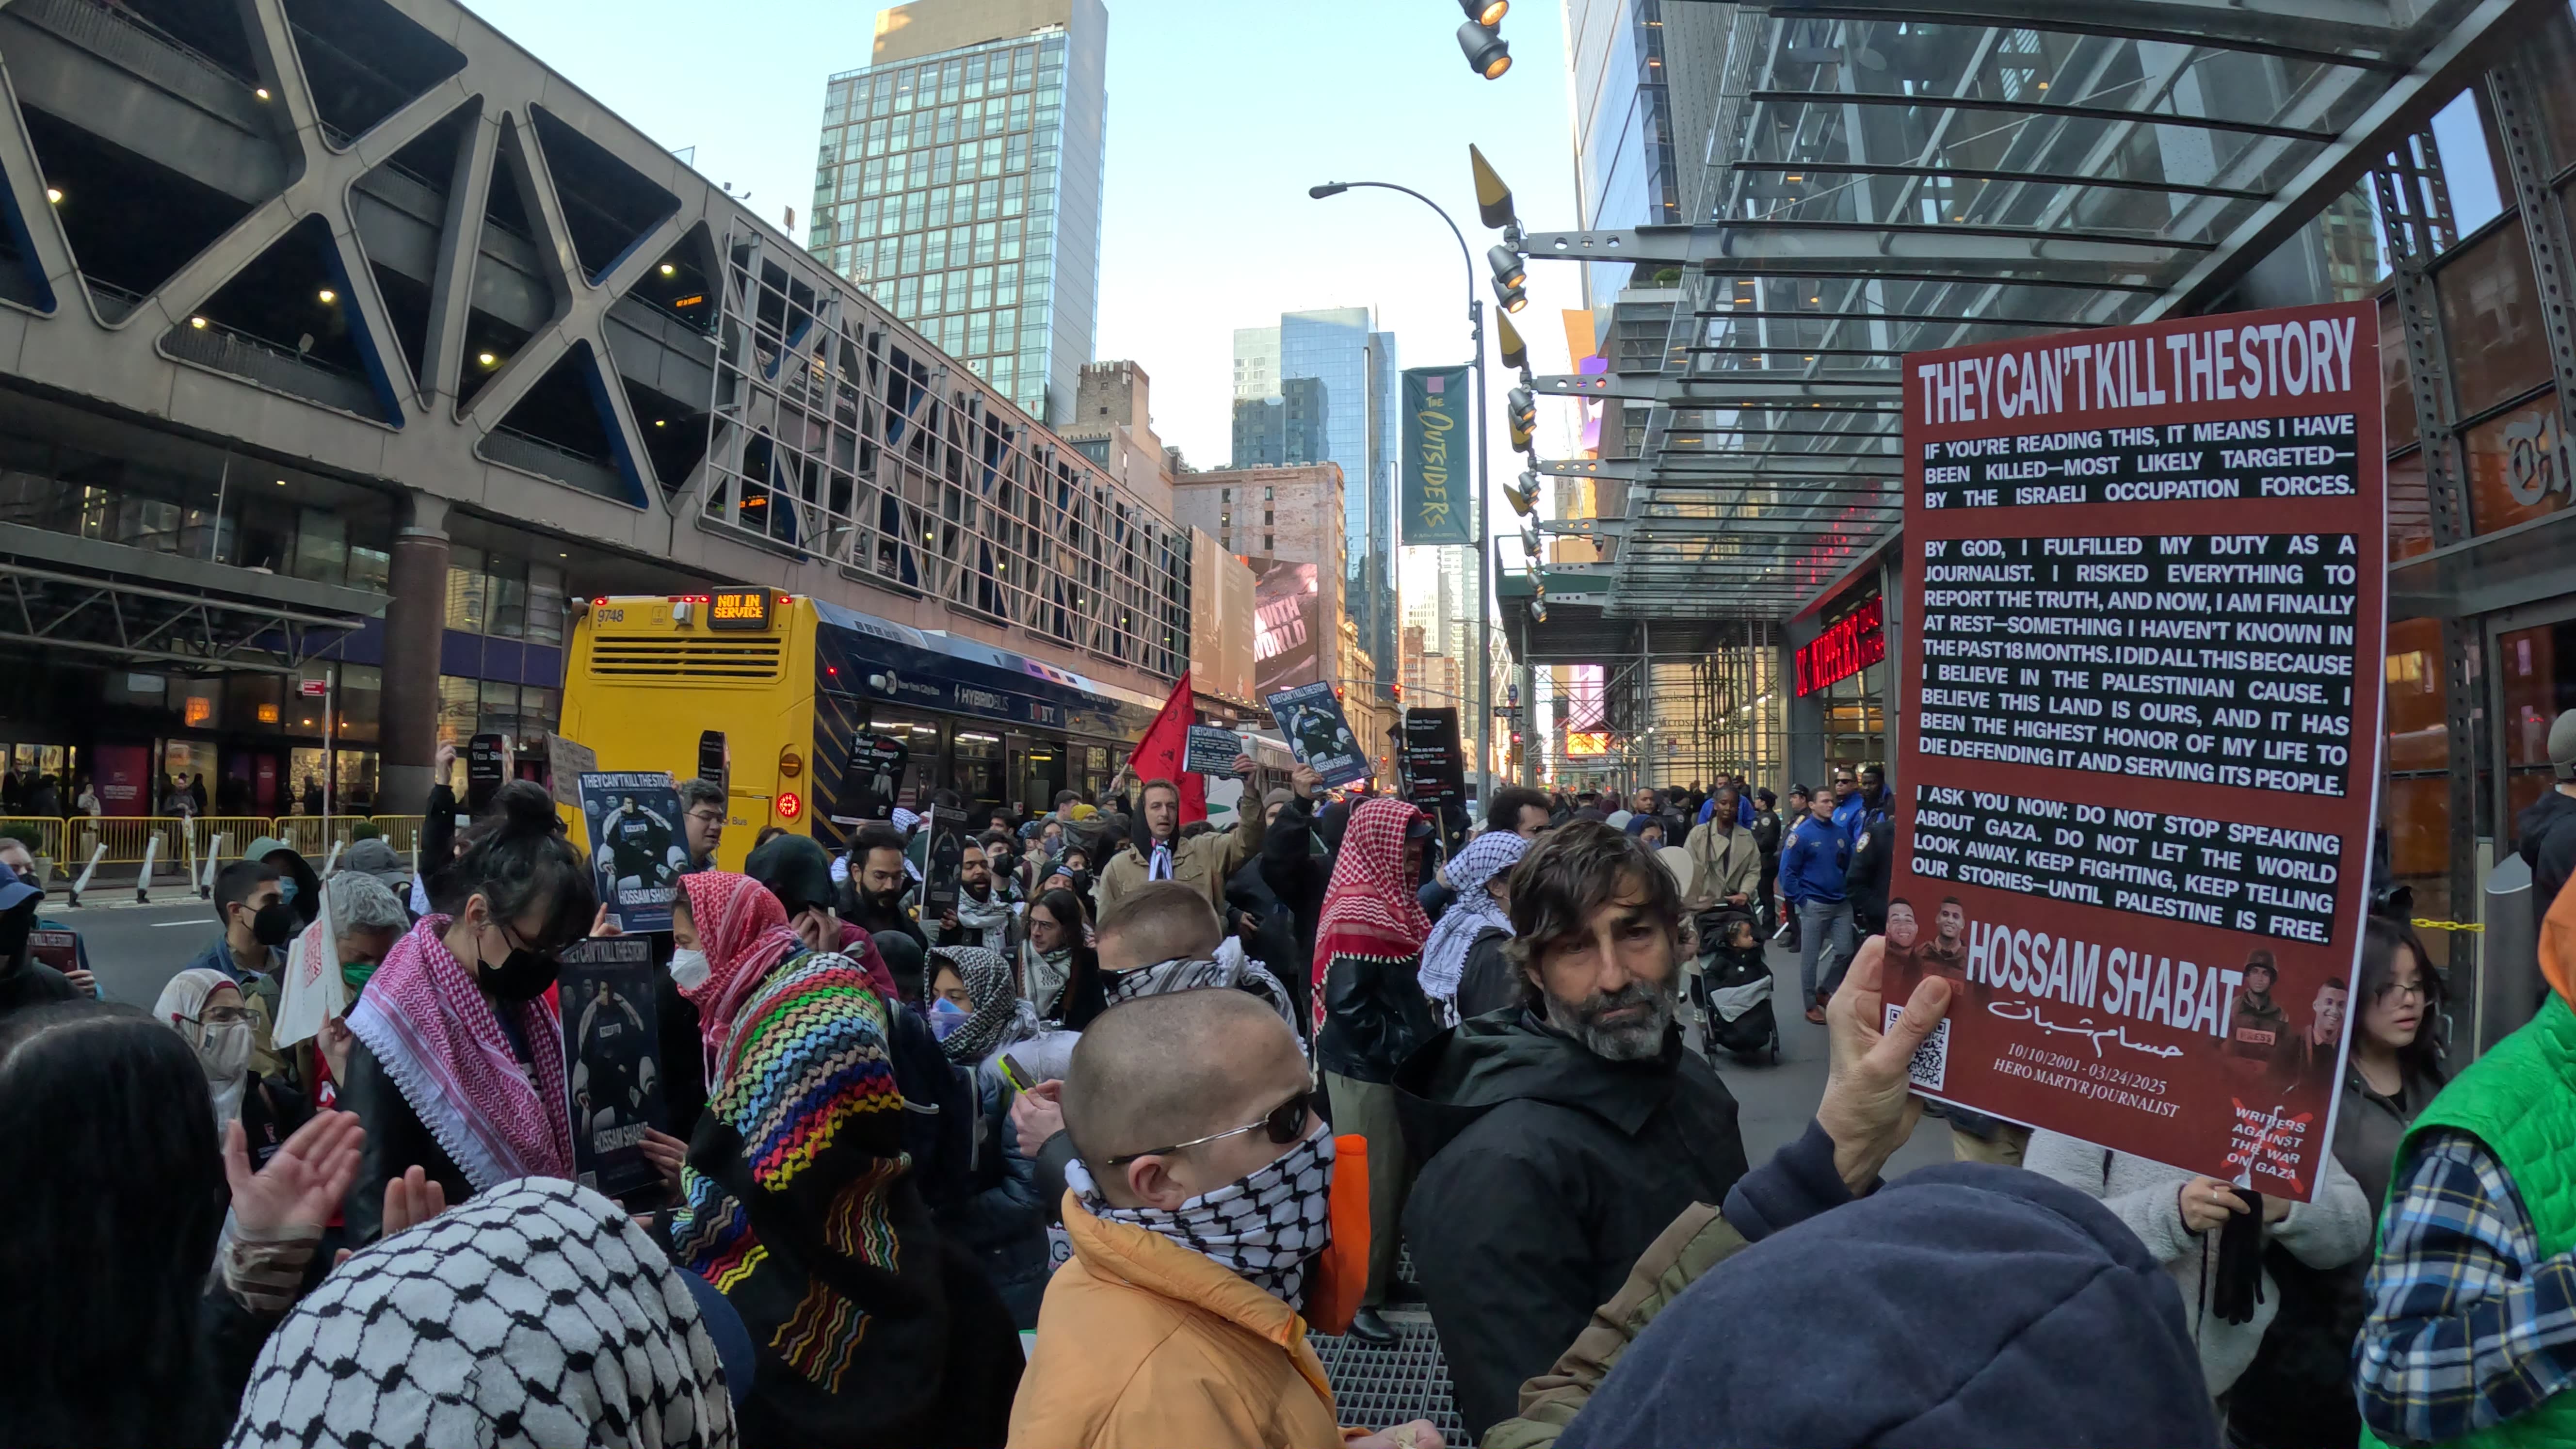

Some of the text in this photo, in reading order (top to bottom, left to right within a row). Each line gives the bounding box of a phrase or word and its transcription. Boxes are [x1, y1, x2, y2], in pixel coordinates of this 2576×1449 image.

[1918, 317, 2356, 425] THEY CAN'T KILL THE STORY
[1925, 415, 2354, 460] IF YOU'RE READING THIS, IT MEANS I HAVE
[1925, 466, 1970, 484] BEEN
[2137, 451, 2203, 473] LIKELY
[1925, 474, 2355, 509] BY THE ISRAELI OCCUPATION FORCES.
[1925, 535, 2356, 559] BY GOD, I FULFILLED MY DUTY AS A
[1924, 564, 2355, 585] JOURNALIST. I RISKED EVERYTHING TO
[597, 609, 624, 623] 9748
[714, 606, 763, 619] SERVICE
[718, 595, 760, 607] NOT IN
[1924, 590, 2355, 615] REPORT THE TRUTH, AND NOW, I AM FINALLY
[1923, 614, 1946, 631] AT
[2128, 619, 2134, 637] I
[2141, 619, 2231, 640] HAVEN'T
[2237, 622, 2322, 644] KNOWN
[2330, 625, 2353, 645] IN
[1922, 639, 2352, 676] THE PAST 18 MONTHS. I DID ALL THIS BECAUSE
[1922, 663, 2089, 689] I BELIEVE IN THE
[582, 774, 601, 788] THEY
[600, 773, 624, 788] CAN'T
[623, 773, 641, 788] KILL
[638, 773, 653, 788] THE
[1919, 737, 2344, 796] DIE DEFENDING IT AND SERVING ITS PEOPLE.
[1916, 785, 2339, 855] I ASK YOU NOW: DO NOT STOP SPEAKING
[1915, 809, 2337, 884] ABOUT GAZA. DO NOT LET THE WORLD
[1914, 833, 2333, 914] LOOK AWAY. KEEP FIGHTING, KEEP TELLING
[619, 888, 651, 905] HOSSAM
[1912, 857, 1948, 878] OUR
[2115, 890, 2223, 925] PALESTINE
[2236, 910, 2257, 930] IS
[2269, 915, 2329, 943] FREE.
[1966, 920, 2243, 1039] HOSSAM SHABAT
[1987, 1000, 2184, 1059] حسام شبات
[2007, 1042, 2080, 1073] 10/10/2001
[2088, 1063, 2168, 1095] 03/24/2025
[1993, 1058, 2181, 1118] HERO MARTYR JOURNALIST
[2232, 1123, 2304, 1148] AGAINST
[2236, 1107, 2306, 1133] WRITERS
[2226, 1152, 2296, 1180] ON GAZA
[2231, 1137, 2301, 1164] THE WAR
